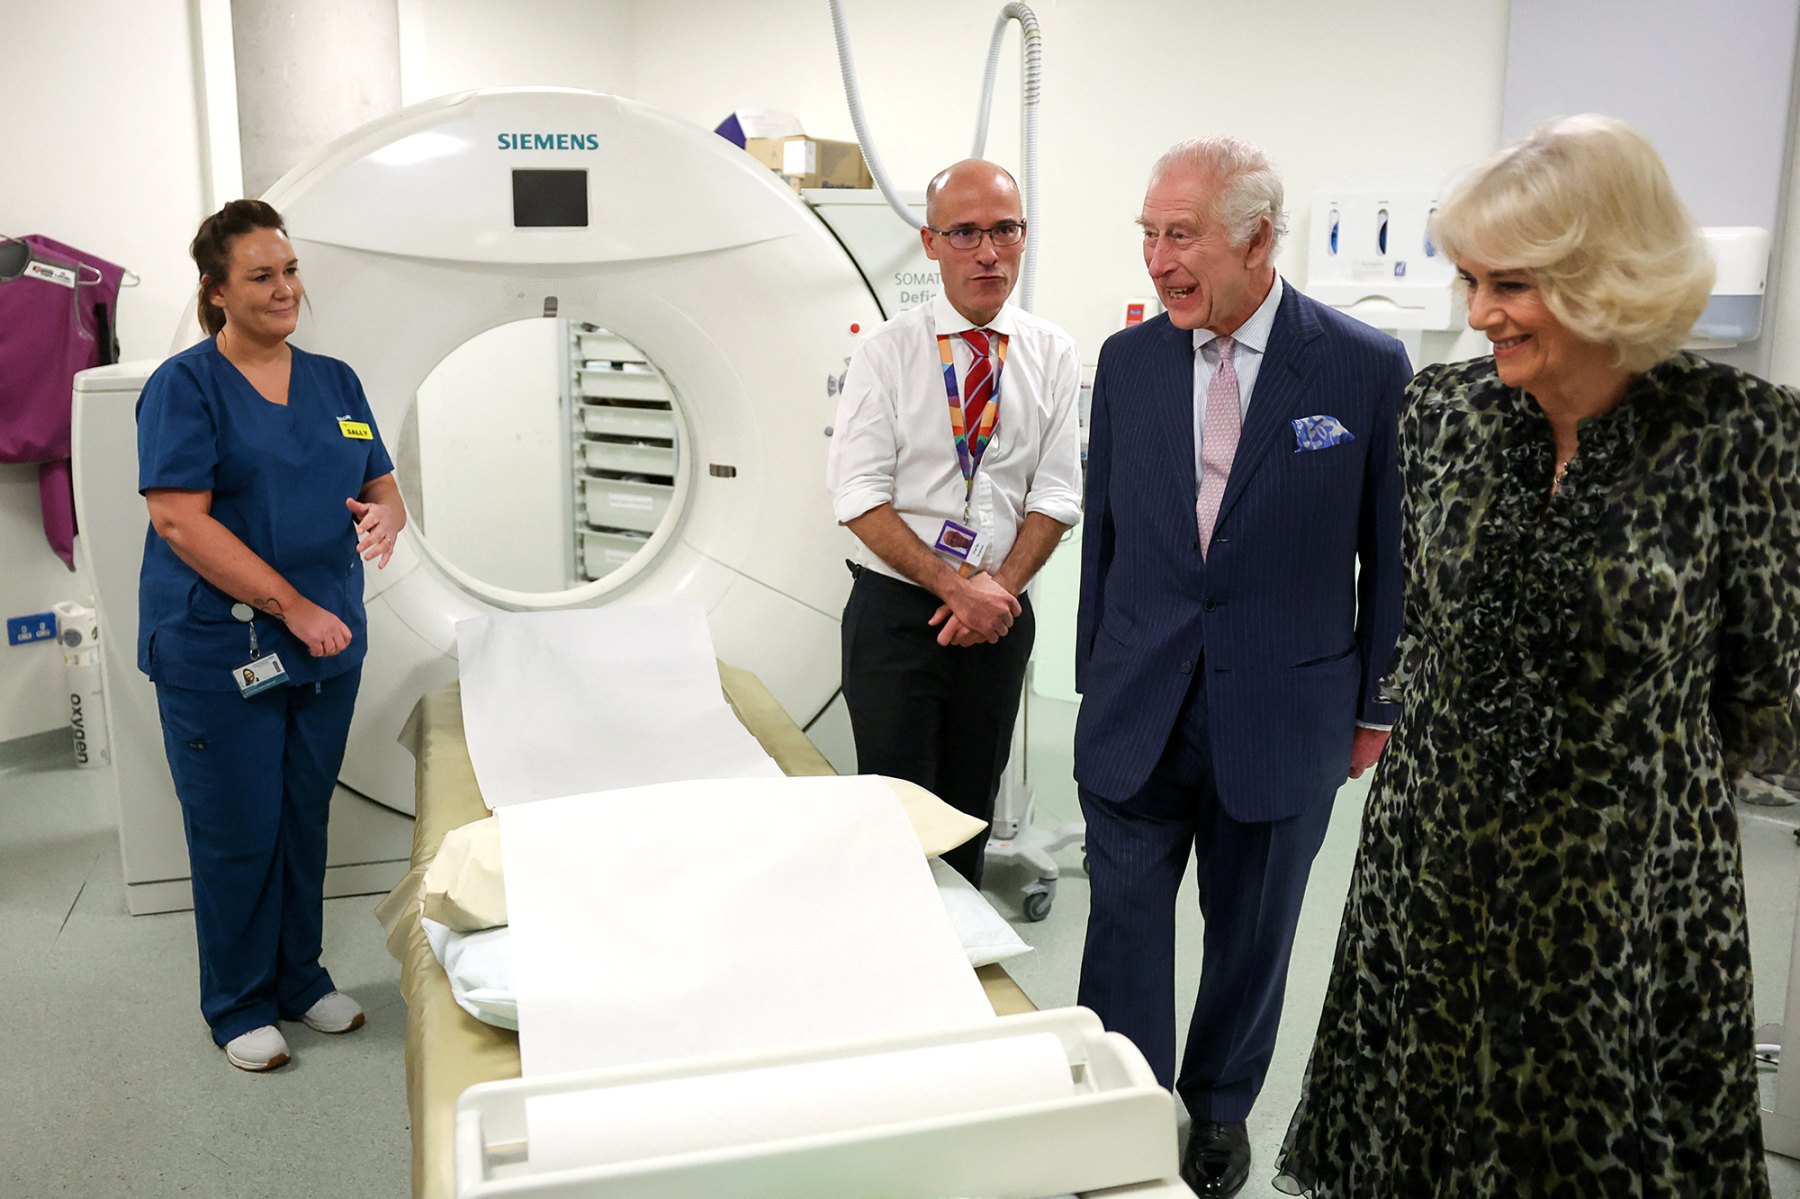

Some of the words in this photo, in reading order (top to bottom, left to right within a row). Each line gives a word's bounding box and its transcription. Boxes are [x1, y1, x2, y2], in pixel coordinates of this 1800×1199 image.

[497, 133, 599, 150] SIEMENS
[894, 272, 940, 286] SOMAT
[346, 428, 368, 436] SALLY
[70, 693, 89, 764] oxygen
